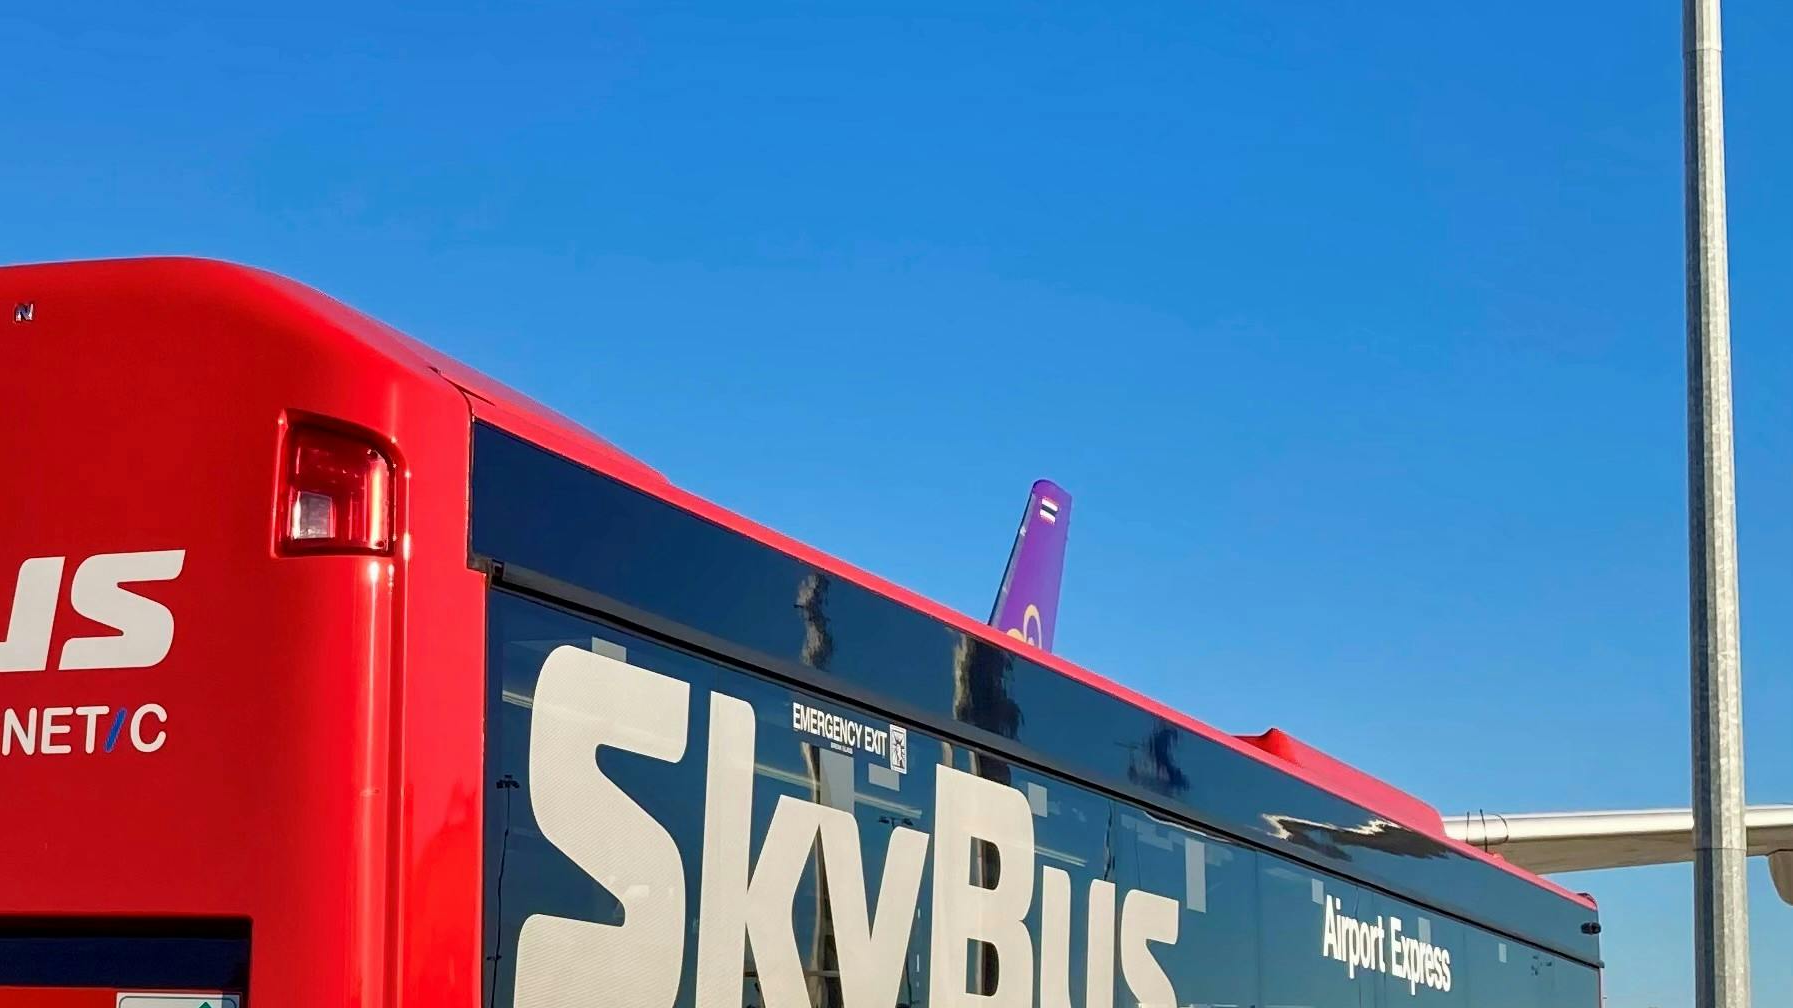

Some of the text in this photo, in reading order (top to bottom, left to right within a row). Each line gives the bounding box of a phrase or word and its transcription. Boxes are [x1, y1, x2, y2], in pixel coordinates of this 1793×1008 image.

[792, 701, 888, 757] EMERGENCY EXIT
[1323, 894, 1451, 996] Airport Express
